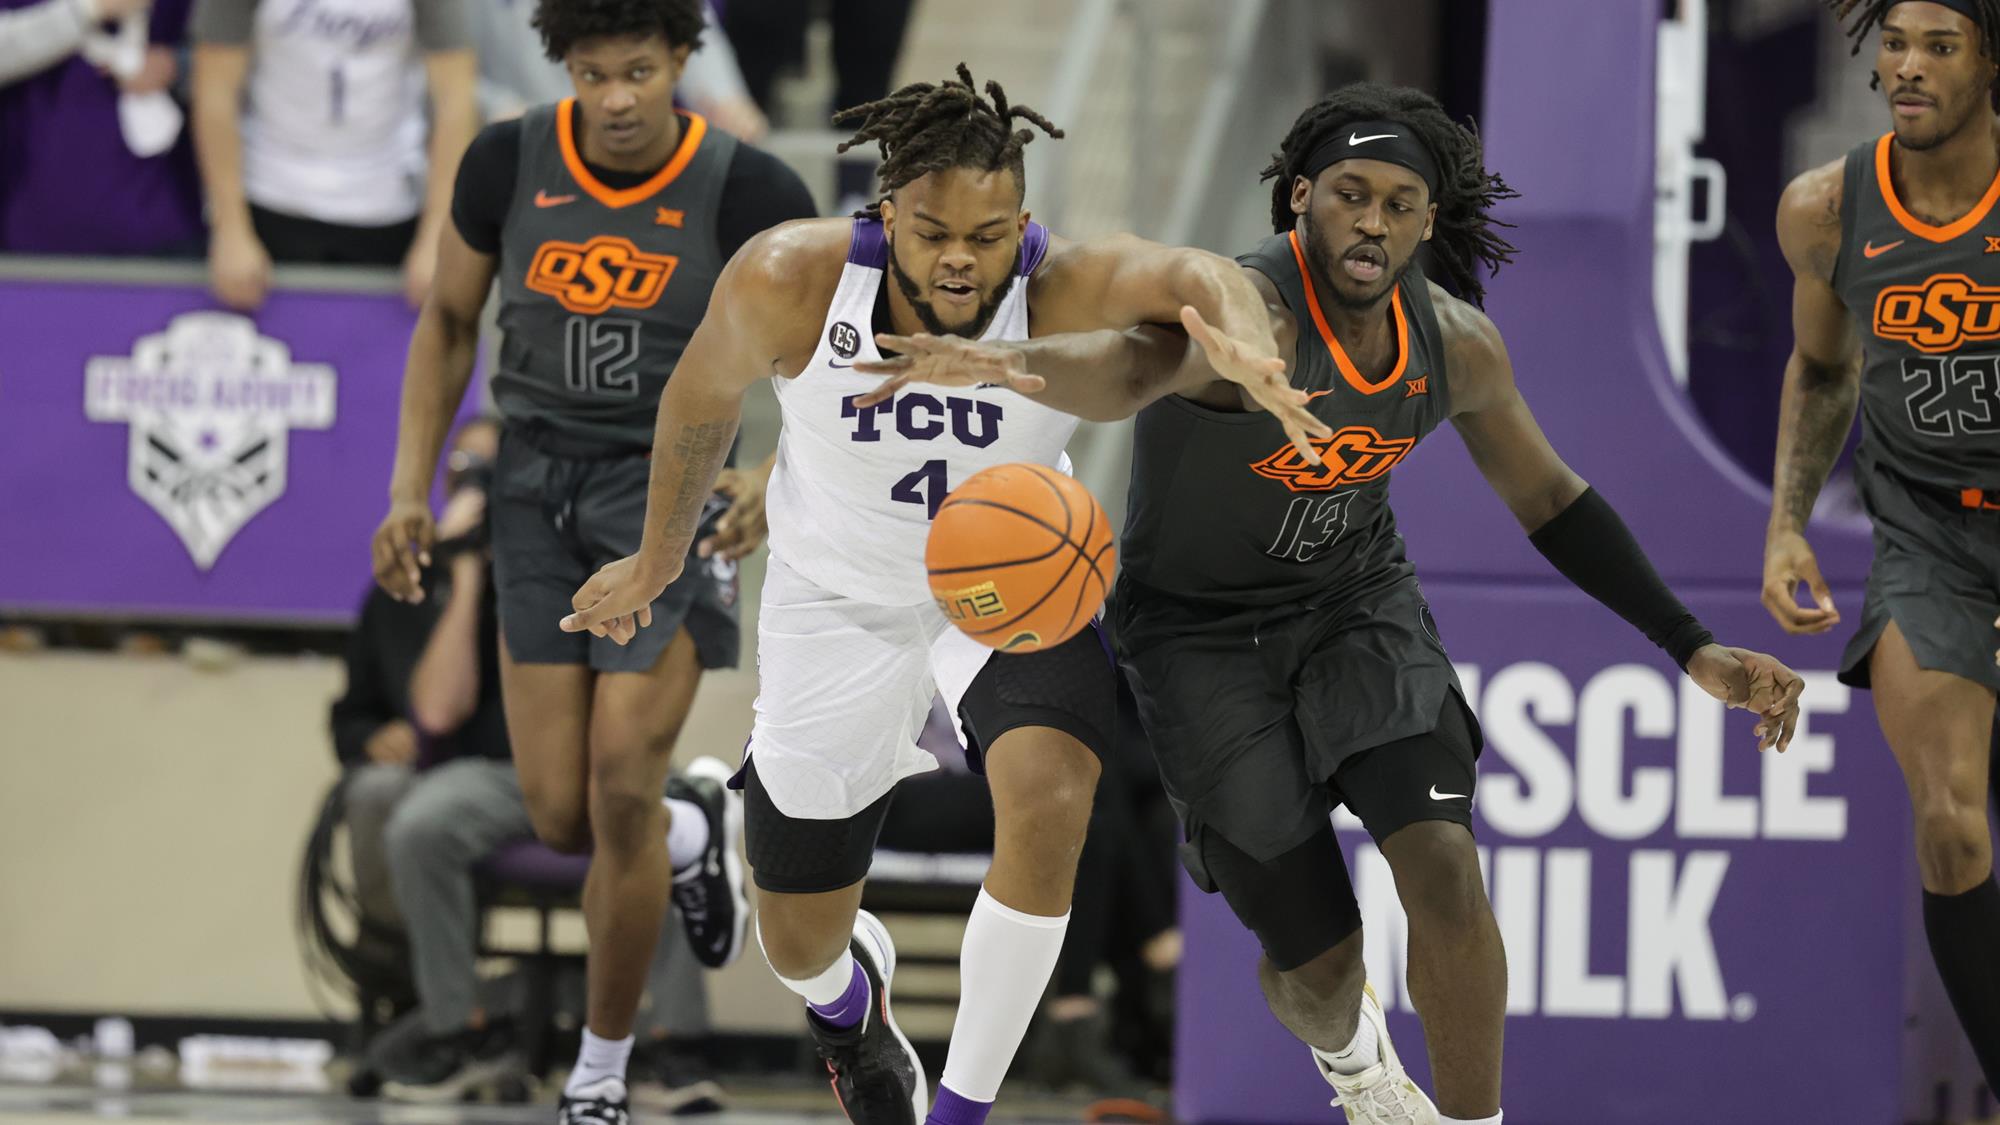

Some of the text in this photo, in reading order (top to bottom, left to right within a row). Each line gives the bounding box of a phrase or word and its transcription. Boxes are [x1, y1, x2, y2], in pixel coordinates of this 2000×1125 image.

[525, 236, 679, 314] OSU
[1873, 273, 2000, 352] OSU
[565, 315, 642, 396] 12
[833, 323, 858, 352] ES
[841, 392, 1003, 448] TCU
[1901, 355, 2000, 436] 23
[891, 459, 951, 520] 4
[1249, 426, 1416, 492] OSU
[1266, 489, 1359, 562] 13
[1330, 661, 1850, 840] SCLE
